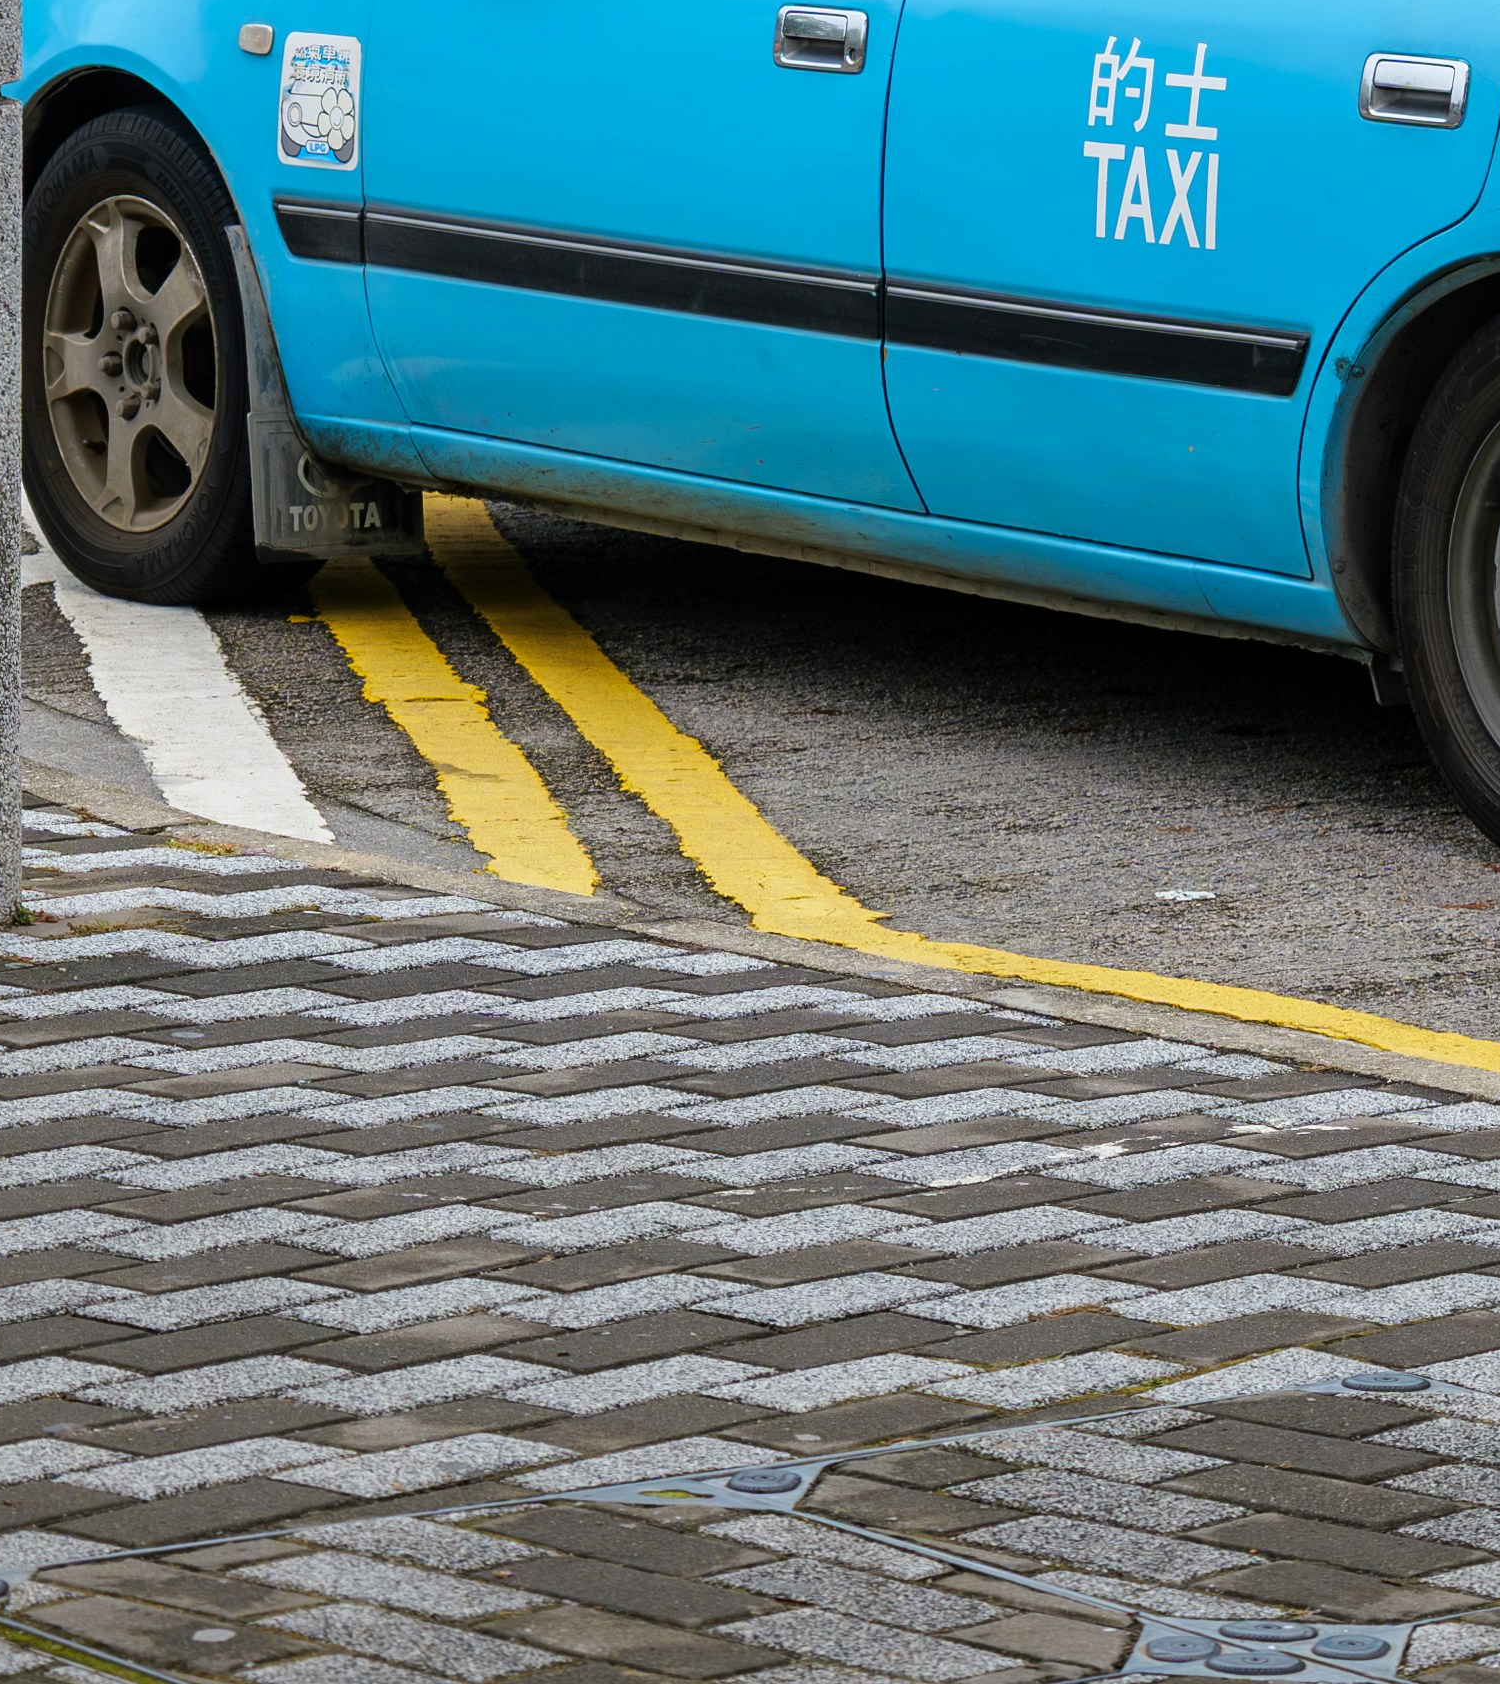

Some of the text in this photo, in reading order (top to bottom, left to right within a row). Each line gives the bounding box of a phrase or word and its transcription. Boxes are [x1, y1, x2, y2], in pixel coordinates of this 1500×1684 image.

[1088, 36, 1227, 141] 的士
[309, 142, 326, 153] LPG
[1083, 141, 1219, 250] TAXI
[289, 501, 382, 532] TOYOTA
